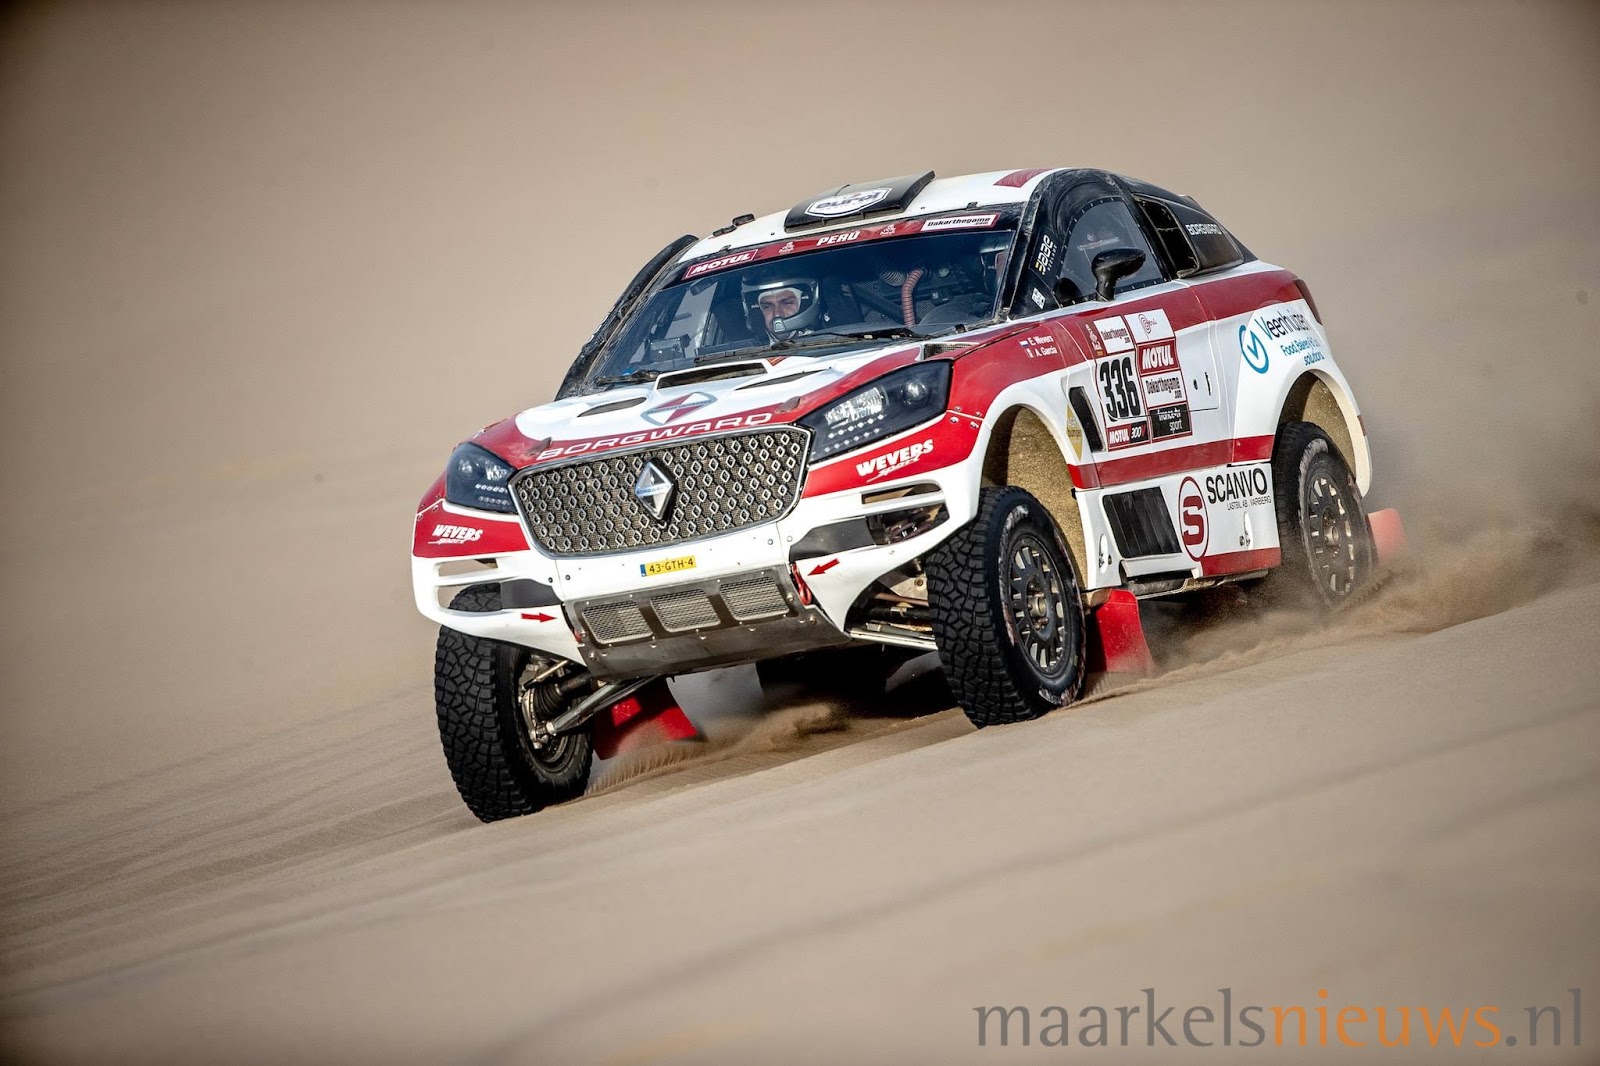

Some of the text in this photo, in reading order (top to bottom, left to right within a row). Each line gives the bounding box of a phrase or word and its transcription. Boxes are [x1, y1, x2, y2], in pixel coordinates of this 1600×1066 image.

[927, 217, 991, 227] Dakarthegame
[692, 252, 751, 274] MOTUL
[1142, 344, 1175, 370] MOTUL
[1099, 356, 1141, 422] 336
[535, 413, 773, 461] BORGWARD
[1109, 428, 1130, 445] MOTUL
[855, 438, 935, 477] WEVERS
[1206, 468, 1267, 504] SCANVO
[432, 524, 484, 541] WEVERS
[649, 557, 695, 574] 43-GTH-4
